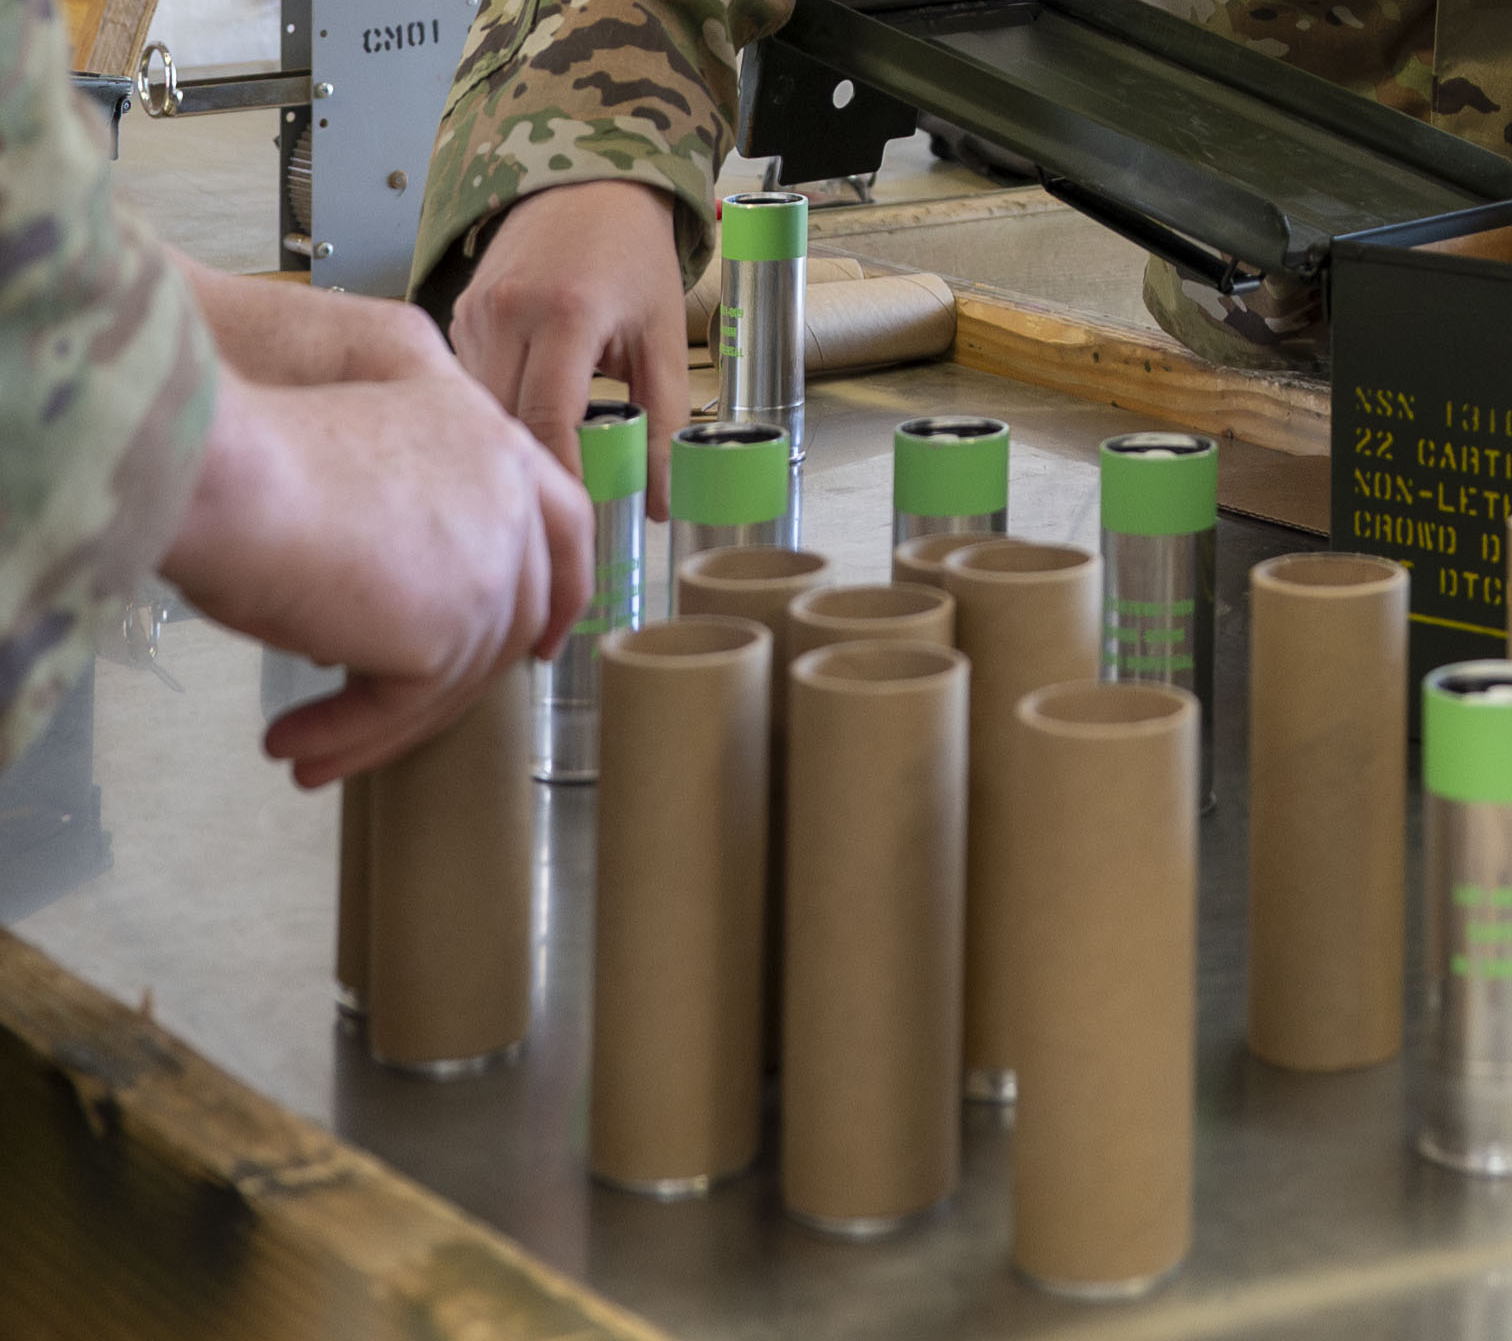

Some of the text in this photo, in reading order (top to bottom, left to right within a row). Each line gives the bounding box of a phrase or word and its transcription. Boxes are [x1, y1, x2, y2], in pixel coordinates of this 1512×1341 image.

[1354, 386, 1415, 421] NSN
[1354, 428, 1393, 460] 22
[1353, 509, 1457, 556] CROWD
